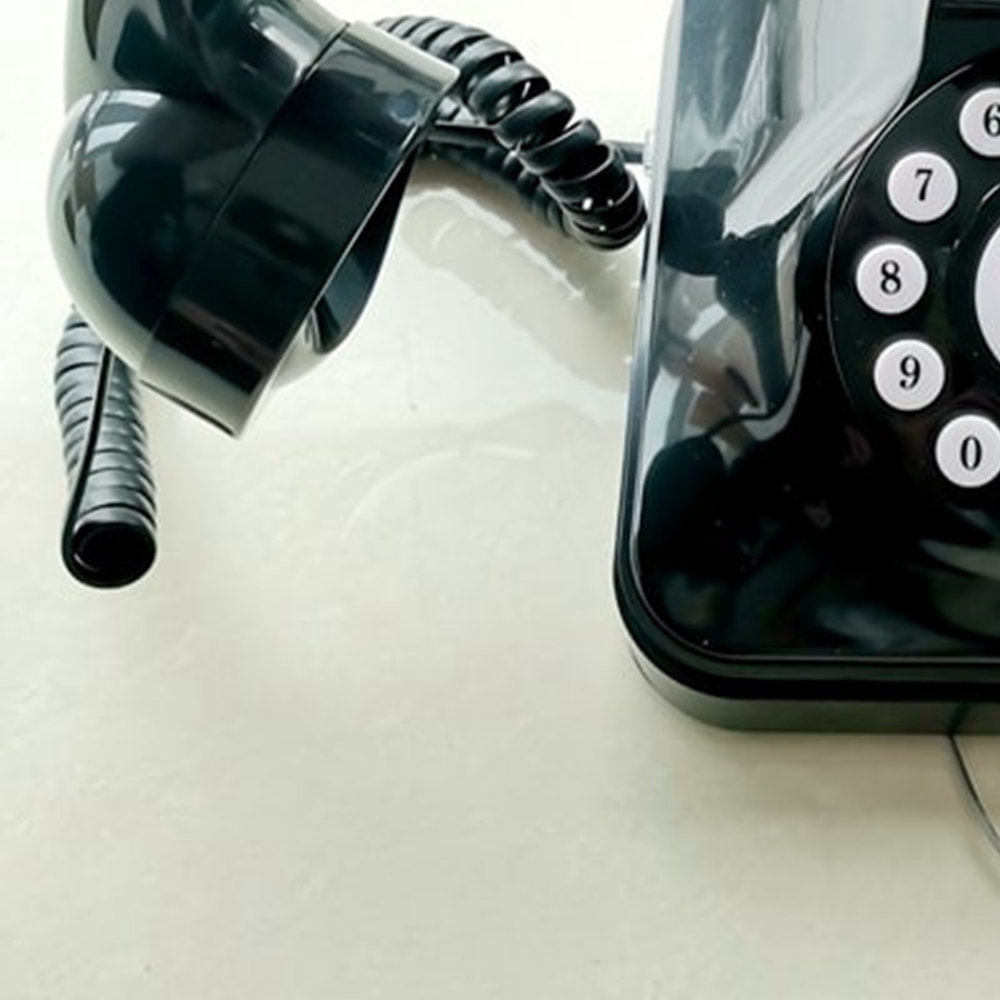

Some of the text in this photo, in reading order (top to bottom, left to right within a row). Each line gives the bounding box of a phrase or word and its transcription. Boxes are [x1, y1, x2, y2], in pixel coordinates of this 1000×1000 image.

[914, 168, 934, 202] 7
[880, 260, 902, 295] 8
[899, 355, 921, 389] 9
[959, 436, 983, 470] 0
